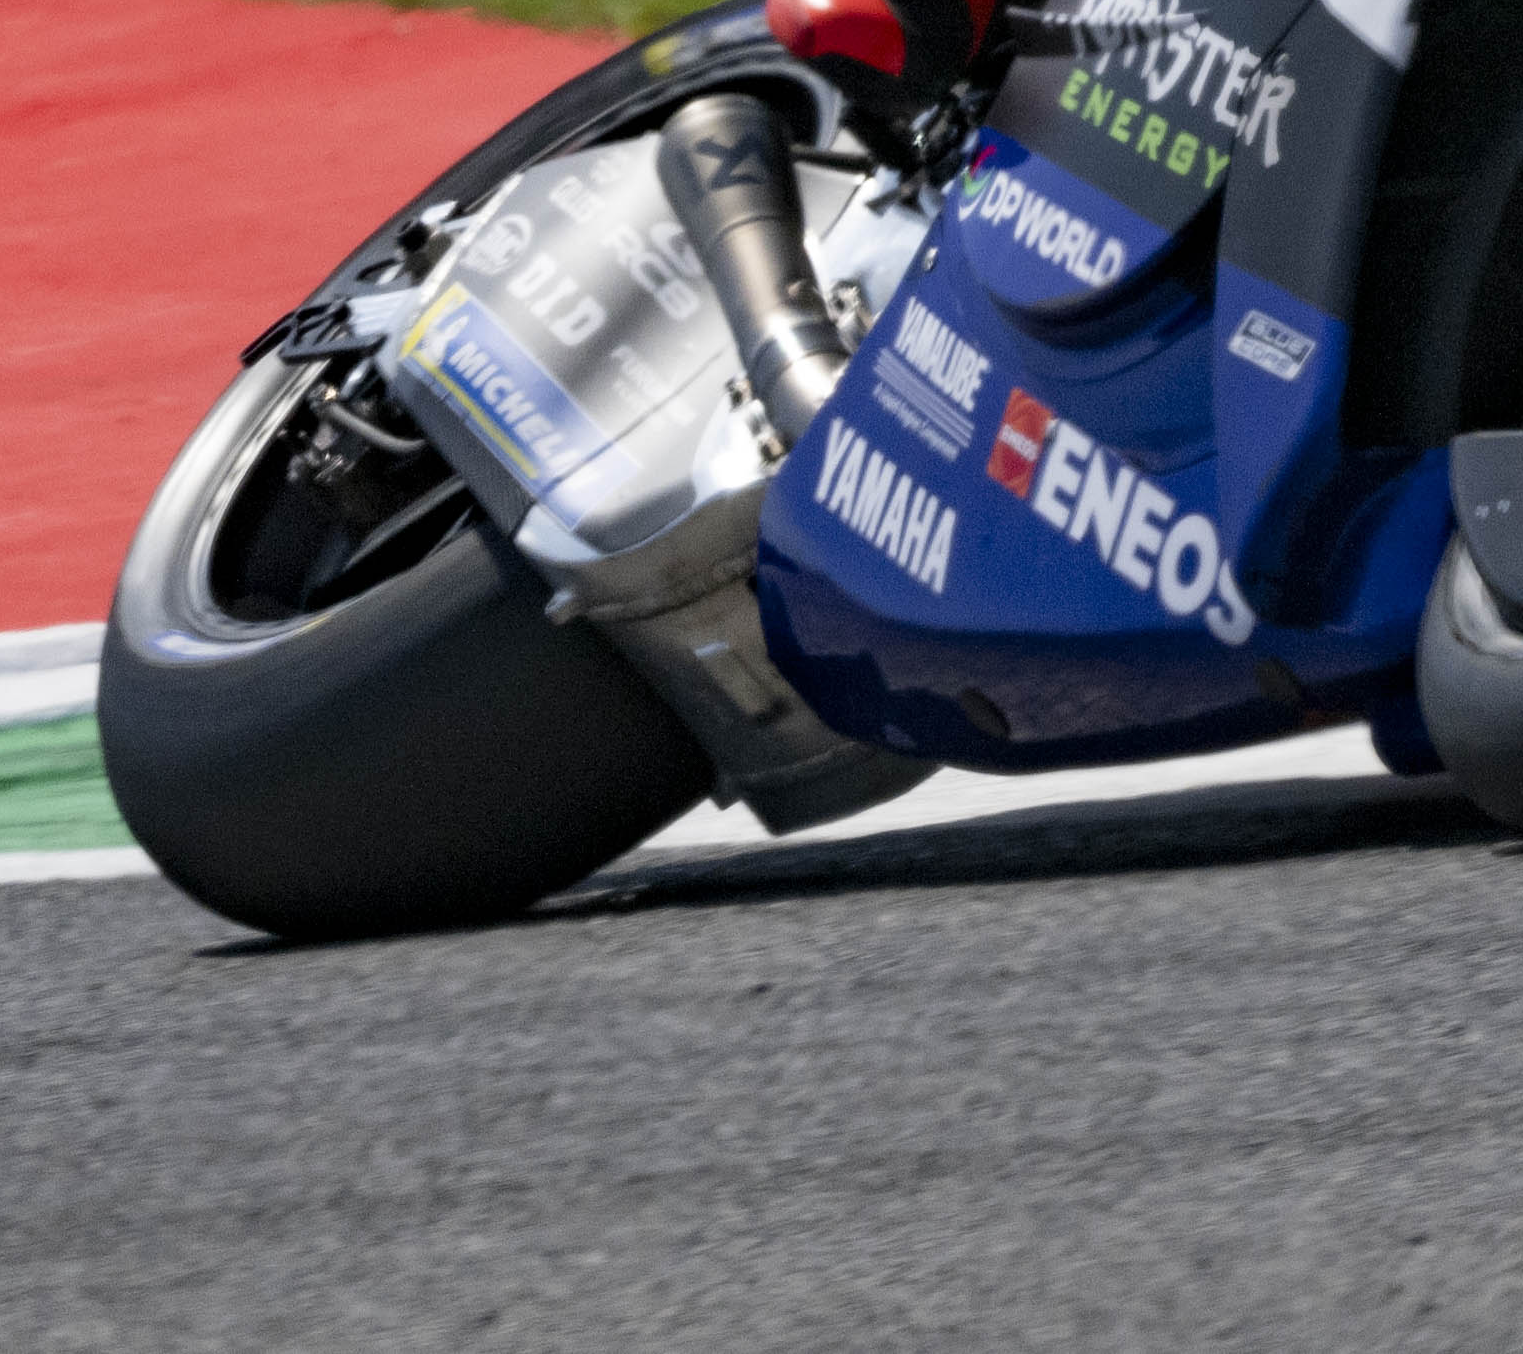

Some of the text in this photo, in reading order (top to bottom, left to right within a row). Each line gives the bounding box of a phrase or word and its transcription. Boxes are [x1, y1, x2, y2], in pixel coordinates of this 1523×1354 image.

[1057, 68, 1231, 190] ENERGY
[447, 339, 603, 489] MICHELI
[893, 295, 992, 414] YAMALUBE
[814, 417, 957, 594] YAMAHA
[1031, 419, 1257, 646] ENEOS
